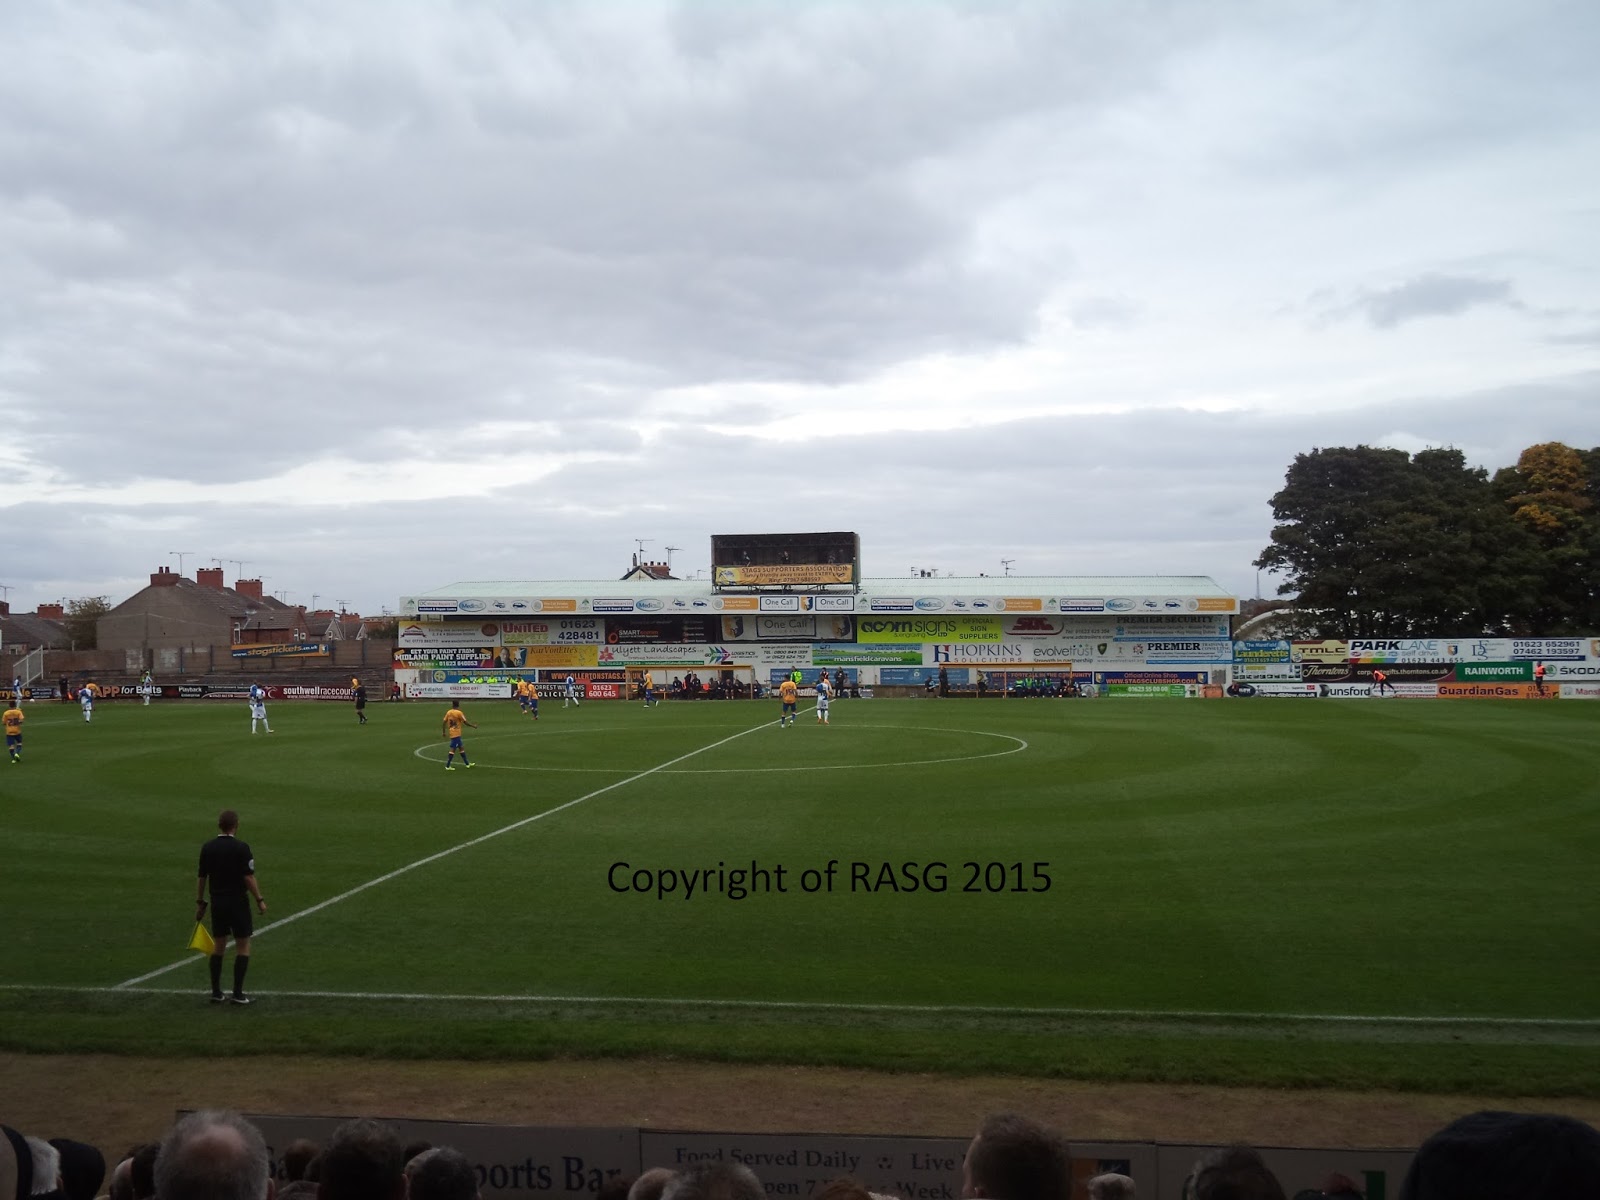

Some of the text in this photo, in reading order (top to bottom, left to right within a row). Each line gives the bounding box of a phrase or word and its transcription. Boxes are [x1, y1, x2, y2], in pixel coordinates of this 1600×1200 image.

[561, 620, 595, 628] 01623
[764, 620, 807, 628] One Call
[861, 621, 956, 636] acorn signs
[232, 644, 318, 657] www.stagstickets.co.uk
[644, 646, 696, 655] Landscapes
[955, 644, 1022, 656] HOPKINS
[1034, 644, 1093, 656] evolvetrust
[1302, 665, 1349, 677] Thorntons
[1560, 666, 1600, 674] ŠKODA
[283, 686, 353, 695] southwellracecours
[1439, 686, 1518, 695] GuardianGas
[730, 1149, 798, 1166] Served
[806, 1150, 861, 1173] Daily
[912, 1153, 954, 1170] Live
[474, 1157, 552, 1190] ports
[766, 1182, 799, 1200] pen
[806, 1180, 816, 1194] 7
[896, 1181, 952, 1200] Week
